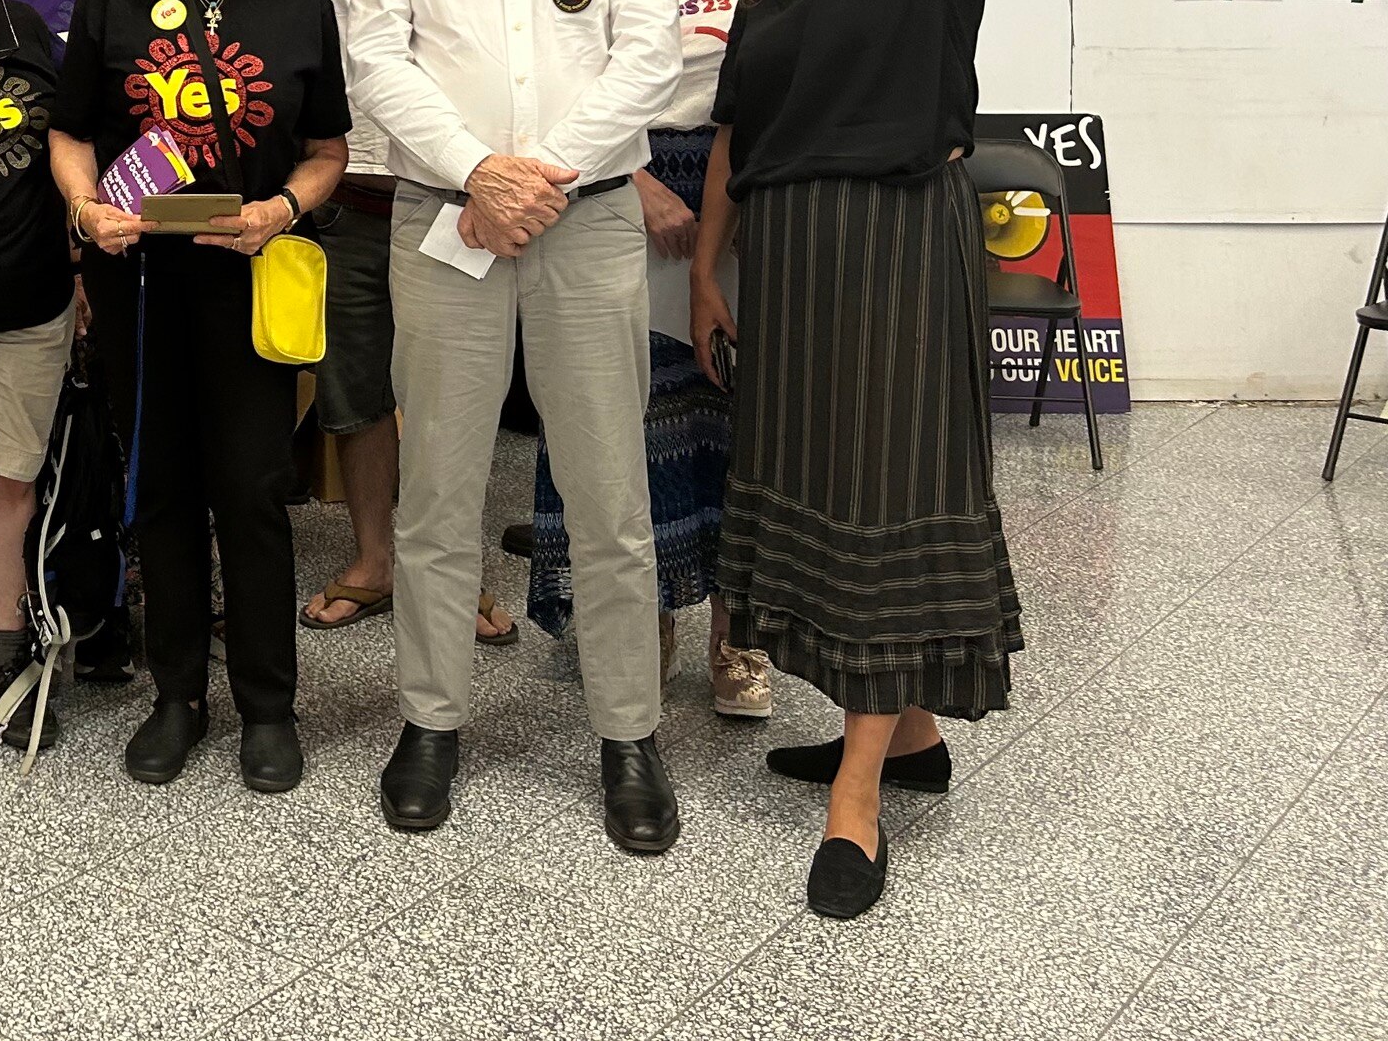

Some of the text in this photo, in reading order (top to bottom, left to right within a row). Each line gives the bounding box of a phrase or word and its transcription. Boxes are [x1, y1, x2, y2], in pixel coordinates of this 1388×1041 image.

[161, 6, 177, 19] Yes
[144, 68, 240, 120] Yes
[123, 153, 132, 166] 14
[1023, 116, 1101, 170] YES
[129, 147, 159, 195] Vote Yes on
[989, 328, 1041, 353] OUR
